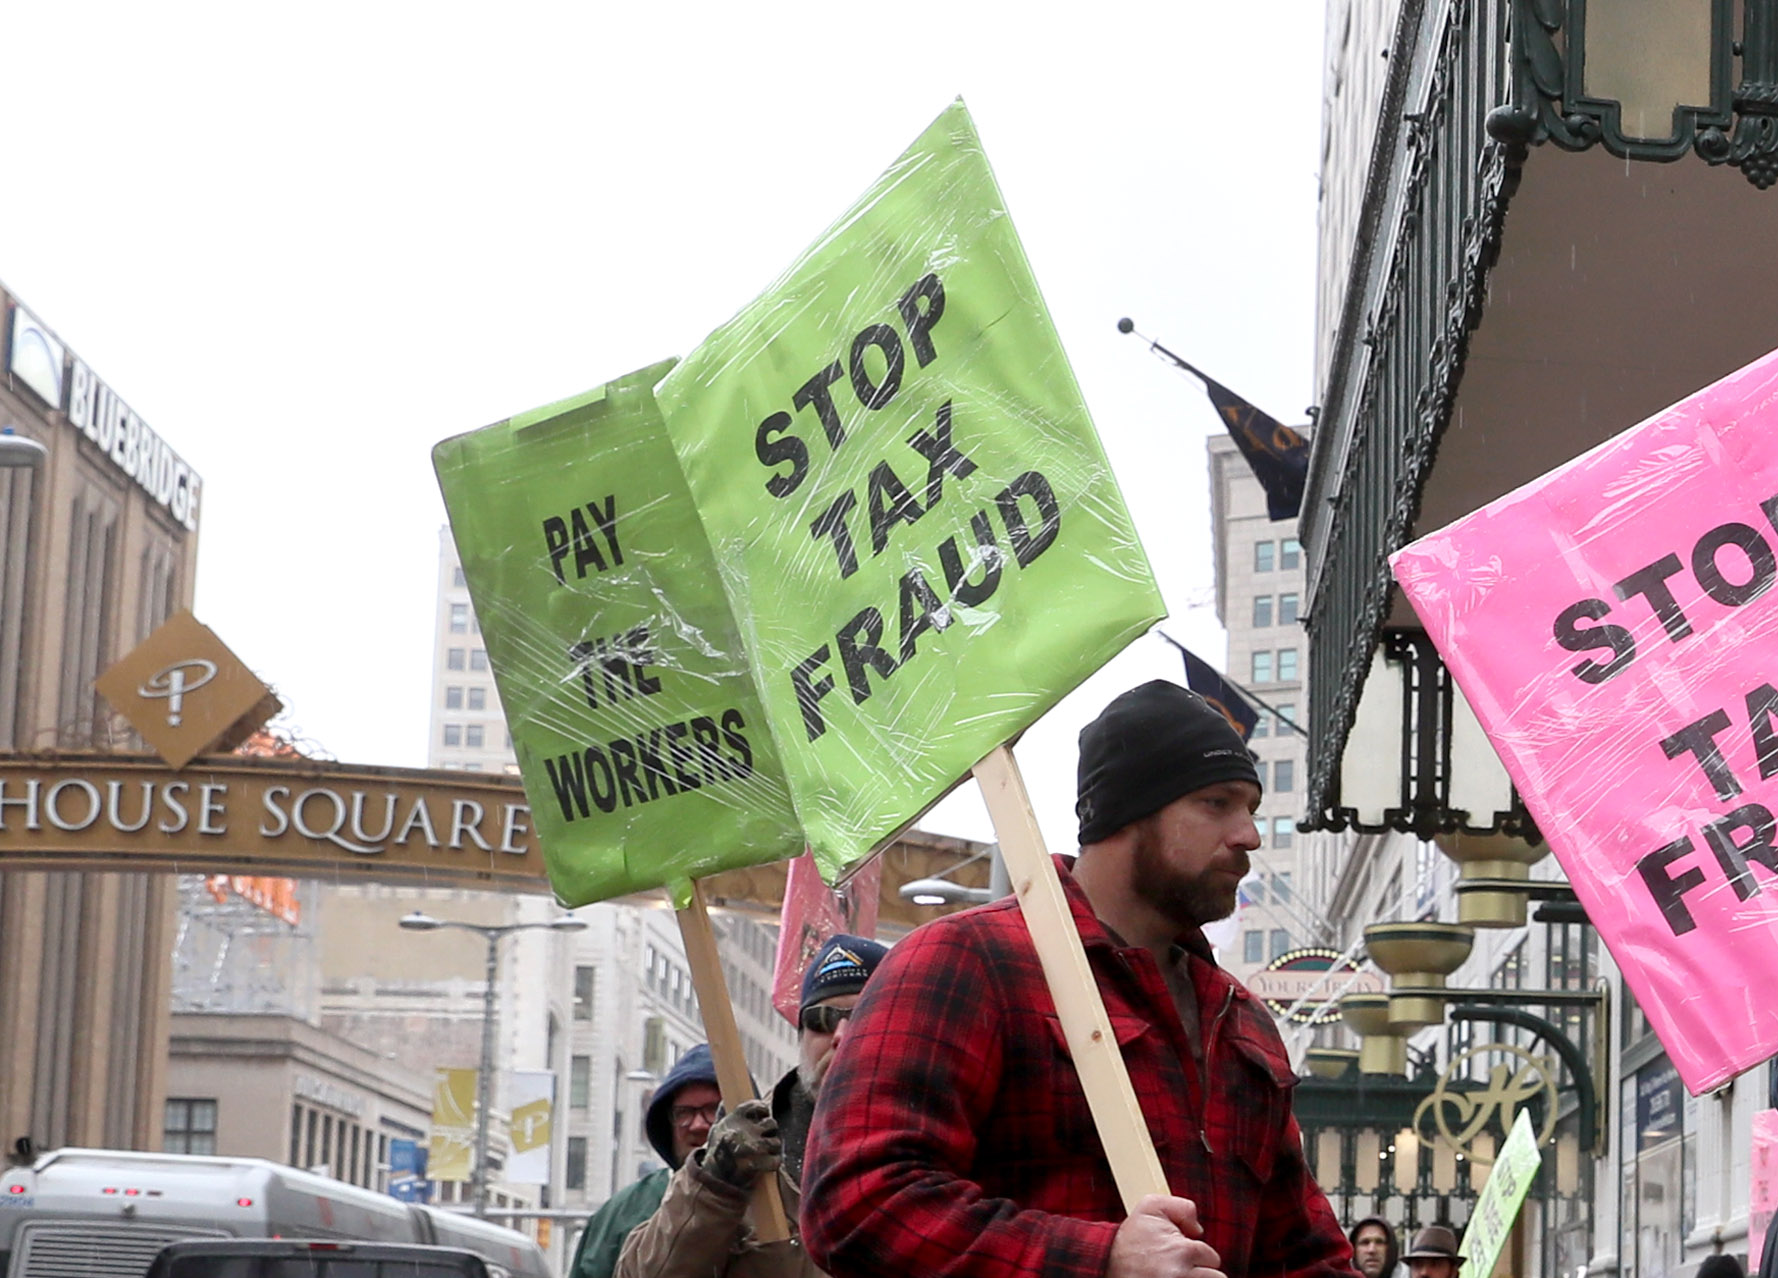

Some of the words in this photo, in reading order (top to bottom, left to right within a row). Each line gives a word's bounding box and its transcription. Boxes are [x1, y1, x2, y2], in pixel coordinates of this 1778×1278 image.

[69, 358, 200, 533] BLUEBRIDGE
[754, 272, 947, 499] STOP
[542, 494, 618, 587] PAY
[810, 401, 978, 580] TAX
[568, 625, 663, 712] THE
[790, 470, 1060, 744] FRAUD
[0, 778, 228, 836] HOUSE
[259, 786, 531, 856] SQUARE
[543, 707, 755, 823] WORKERS
